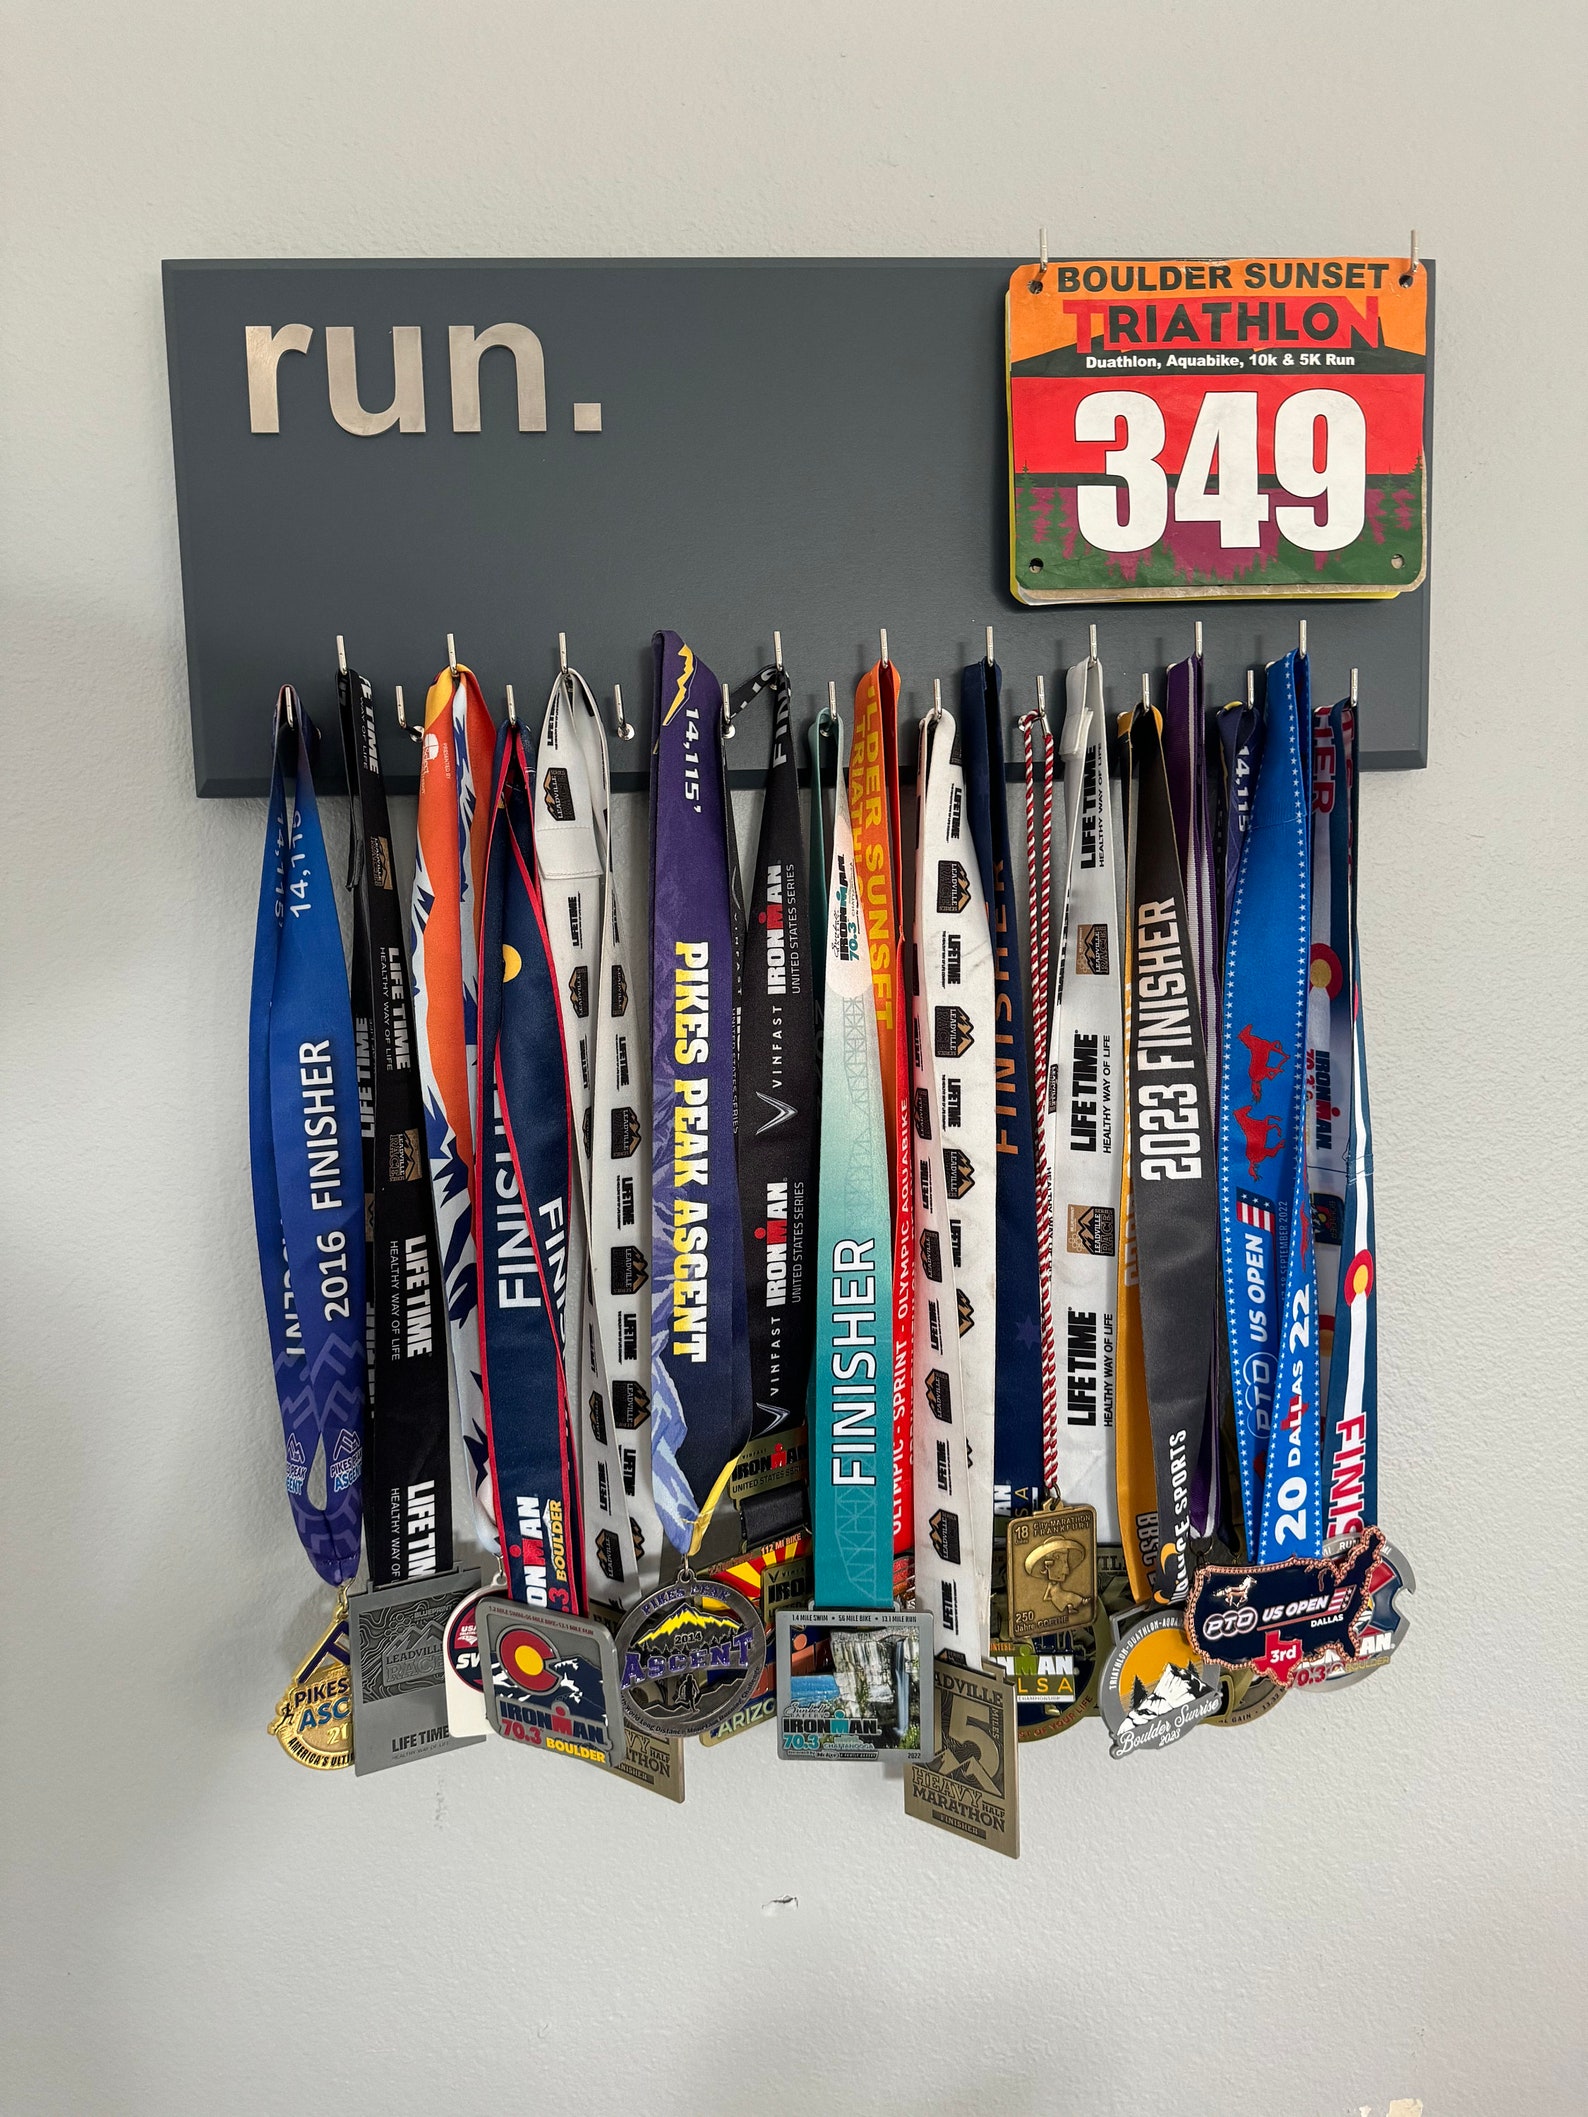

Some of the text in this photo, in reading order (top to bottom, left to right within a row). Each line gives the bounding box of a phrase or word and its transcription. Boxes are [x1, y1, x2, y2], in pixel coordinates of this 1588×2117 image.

[1057, 262, 1390, 293] BOULDER SUNSET
[1063, 296, 1379, 353] TRIATHLON
[245, 322, 602, 436] run.
[1086, 353, 1356, 369] Duathlon, Aquabike, 10k & 5K Run
[1074, 389, 1368, 553] 349
[1081, 744, 1097, 870] LIFE TIME
[758, 864, 788, 995] IRONMAN
[786, 864, 801, 995] UNITED STATES SERIES
[947, 933, 962, 985] LIFETIME
[379, 947, 394, 1071] HEALTHY WAY LIFE
[388, 947, 411, 1070] LIFE TIME
[772, 1004, 783, 1090] VINFAST
[1137, 897, 1202, 1181] 2023 FINISHER
[1070, 1033, 1099, 1152] LIFE TIME
[1103, 1034, 1112, 1154] HEALTHY WAY OF LIFE
[1315, 1049, 1341, 1151] IRONMAN
[299, 1039, 343, 1211] FINISHER
[622, 1109, 631, 1152] LEADVILLE
[398, 1133, 406, 1178] LEADVILLE
[672, 942, 709, 1363] PIKES PEAK ASCENT
[950, 1150, 958, 1194] LEADVILLE
[897, 1097, 910, 1319] OLYMPIC AQUABIKE
[1277, 1200, 1288, 1223] 2022
[625, 1247, 633, 1288] LEADVILLE
[754, 1182, 788, 1308] IRONMAN
[791, 1181, 804, 1304] UNITED STATES SERIES
[1245, 1233, 1267, 1304] OPEN
[316, 1230, 350, 1322] 2016
[390, 1240, 401, 1361] HEALTHY WAY OF LIFE
[405, 1234, 433, 1358] LIFE TIME
[1248, 1309, 1268, 1343] US
[769, 1315, 782, 1397] VINFAST
[831, 1237, 877, 1486] FINISHER
[894, 1341, 907, 1420] SPRINT
[1066, 1311, 1098, 1427] LIFE TIME
[1103, 1313, 1113, 1427] HEALTHY WAY OF LIFE
[626, 1383, 634, 1424] LEADVILLE
[1288, 1360, 1304, 1468] DALLAS
[732, 1471, 784, 1493] UNITED STATES
[1169, 1428, 1189, 1515] SPORTS
[391, 1487, 401, 1577] HEALTHY WAY OF
[407, 1480, 436, 1535] LIFE
[1014, 1525, 1029, 1541] 18
[1275, 1476, 1308, 1546] 20
[547, 1499, 569, 1583] BOULDER
[641, 1587, 686, 1616] PIKES
[1015, 1611, 1034, 1623] 250
[1207, 1613, 1253, 1635] PTO
[1262, 1595, 1329, 1622] US OPEN
[1310, 1614, 1344, 1628] DALLAS
[620, 1630, 754, 1691] ASCENT
[674, 1632, 703, 1645] 2014
[1270, 1646, 1297, 1663] 3rd
[294, 1677, 349, 1708] PIKES
[1049, 1695, 1093, 1731] YOUR LIFE
[392, 1735, 418, 1753] LIFE
[418, 1724, 450, 1745] TIME
[500, 1700, 608, 1746] IRONMAN
[501, 1719, 543, 1745] 70.3
[783, 1709, 880, 1735] IRONMAN
[783, 1734, 819, 1750] 70.3
[991, 1707, 1001, 1741] MILES
[1116, 1716, 1172, 1756] Boulder
[1174, 1697, 1220, 1728] Sunrise
[1158, 1727, 1181, 1747] 2023
[288, 1737, 330, 1767] AMERICA'S
[546, 1737, 606, 1763] BOULDER
[649, 1749, 671, 1764] HALF
[912, 1766, 983, 1808] HEAVY
[912, 1785, 1006, 1833] MARATHON
[982, 1803, 1006, 1819] HALF
[939, 1813, 979, 1835] FINISHER
